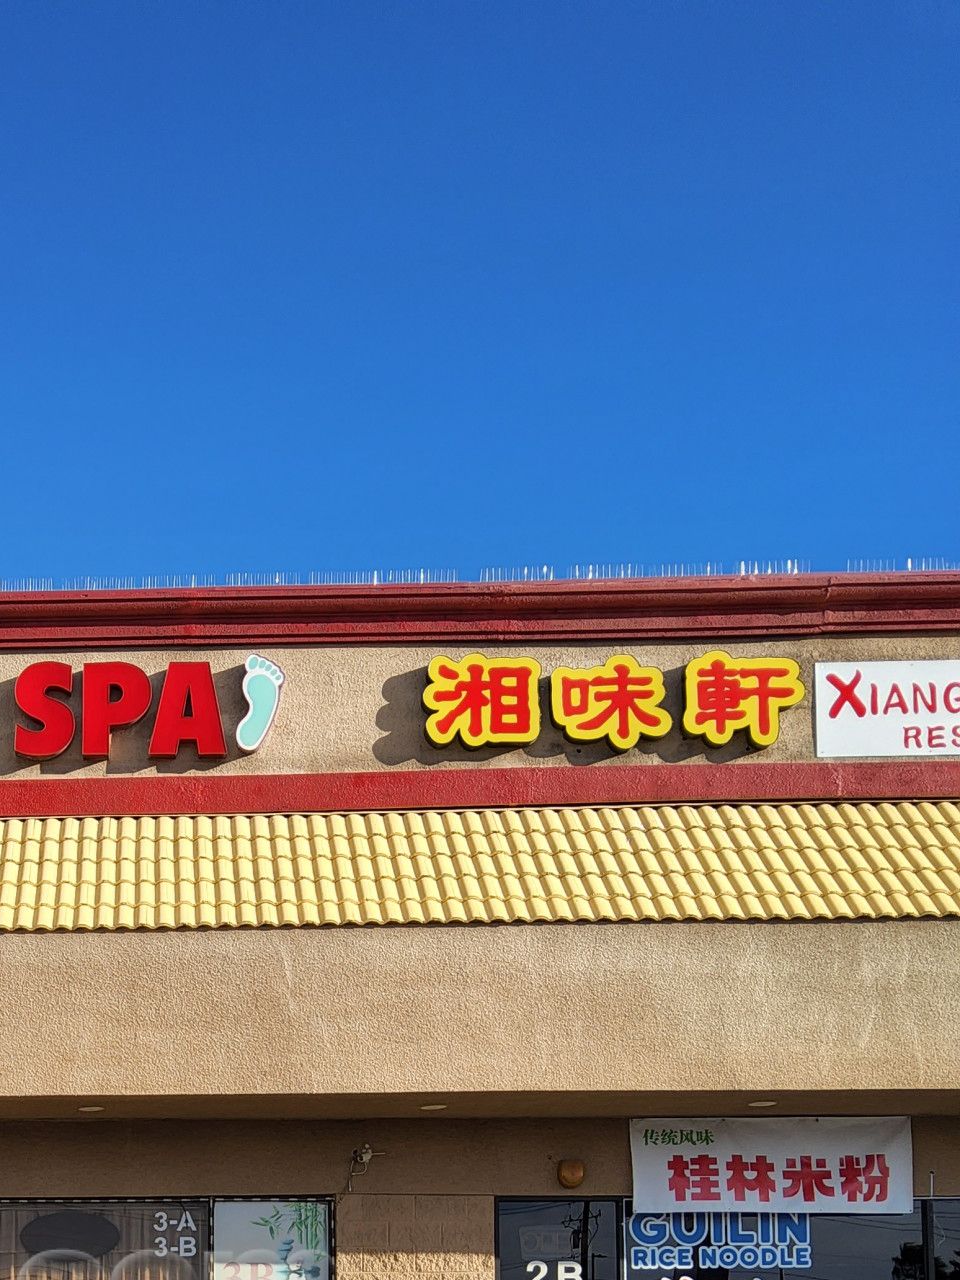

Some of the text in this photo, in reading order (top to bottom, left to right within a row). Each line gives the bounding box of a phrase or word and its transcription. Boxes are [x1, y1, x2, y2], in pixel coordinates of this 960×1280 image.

[13, 660, 227, 761] SPA
[428, 654, 800, 745] 湘味軒
[825, 670, 960, 719] XIANG
[642, 1128, 715, 1147] 传统风味
[667, 1153, 890, 1202] 桂林米粉
[153, 1211, 197, 1232] 3-A
[628, 1212, 812, 1247] GUILIN
[153, 1236, 197, 1257] 3-B
[631, 1245, 812, 1269] RICE NOODLE
